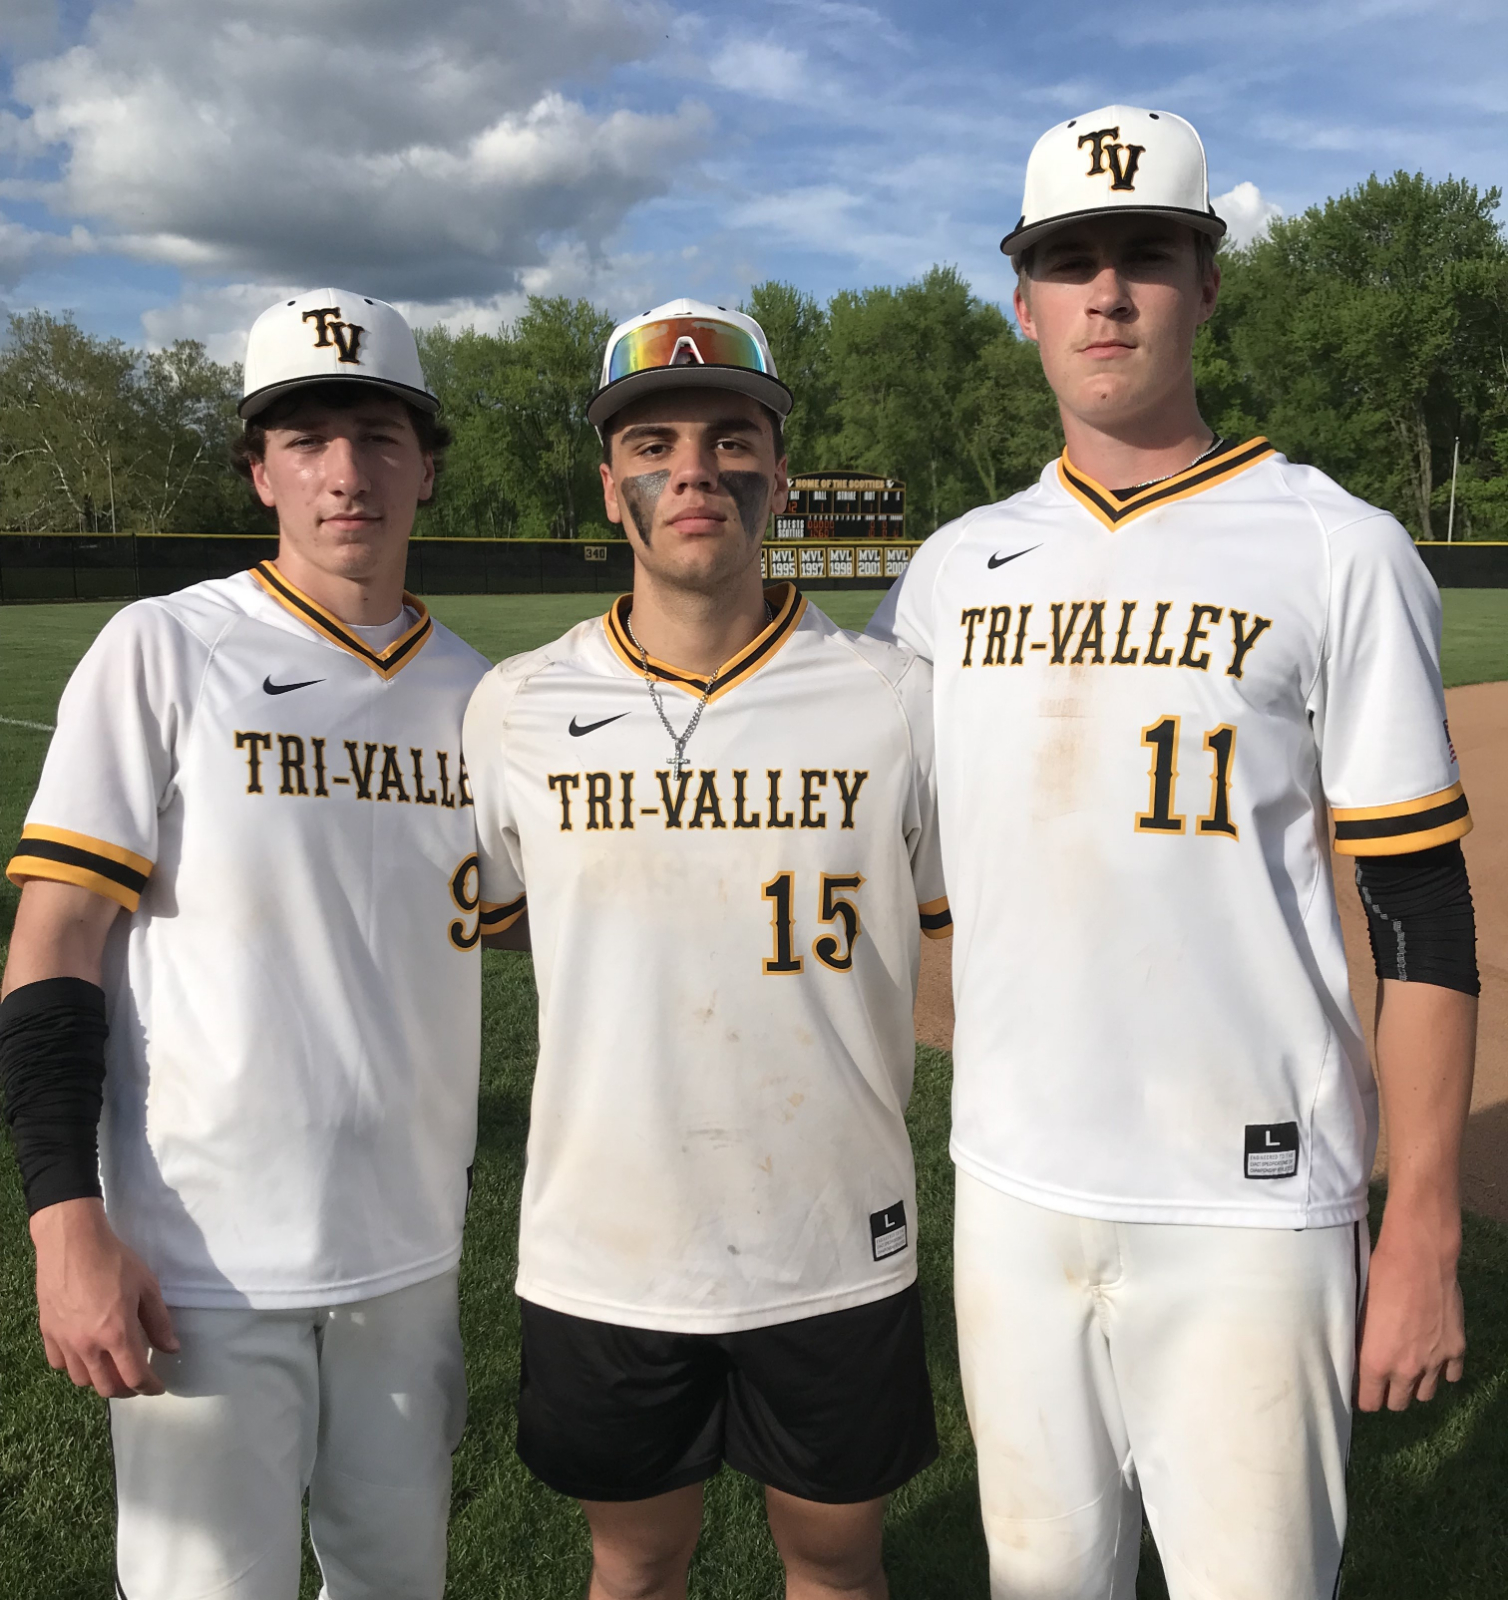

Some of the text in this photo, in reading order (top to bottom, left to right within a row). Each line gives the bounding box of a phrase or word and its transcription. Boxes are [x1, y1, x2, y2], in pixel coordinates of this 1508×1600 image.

[1077, 126, 1146, 193] TV
[302, 306, 365, 365] TV
[795, 479, 885, 488] HOME OF THE SCOTTIES
[777, 520, 805, 529] GUESTS
[778, 529, 805, 538] SCOTTIES
[586, 548, 605, 558] 340
[772, 551, 795, 561] MVL
[801, 550, 824, 561] MVL
[830, 550, 852, 561] MVL
[858, 550, 880, 561] MVL
[887, 550, 909, 561] MVL
[772, 562, 795, 576] 1995
[801, 562, 824, 576] 1997
[830, 562, 852, 575] 1998
[858, 562, 881, 575] 2001
[960, 599, 1274, 681] TRI-VALLEY
[1133, 714, 1240, 843] 11
[547, 768, 870, 833] TRI-VALLEY
[760, 870, 867, 976] 15
[1265, 1130, 1281, 1146] L
[884, 1213, 896, 1228] L
